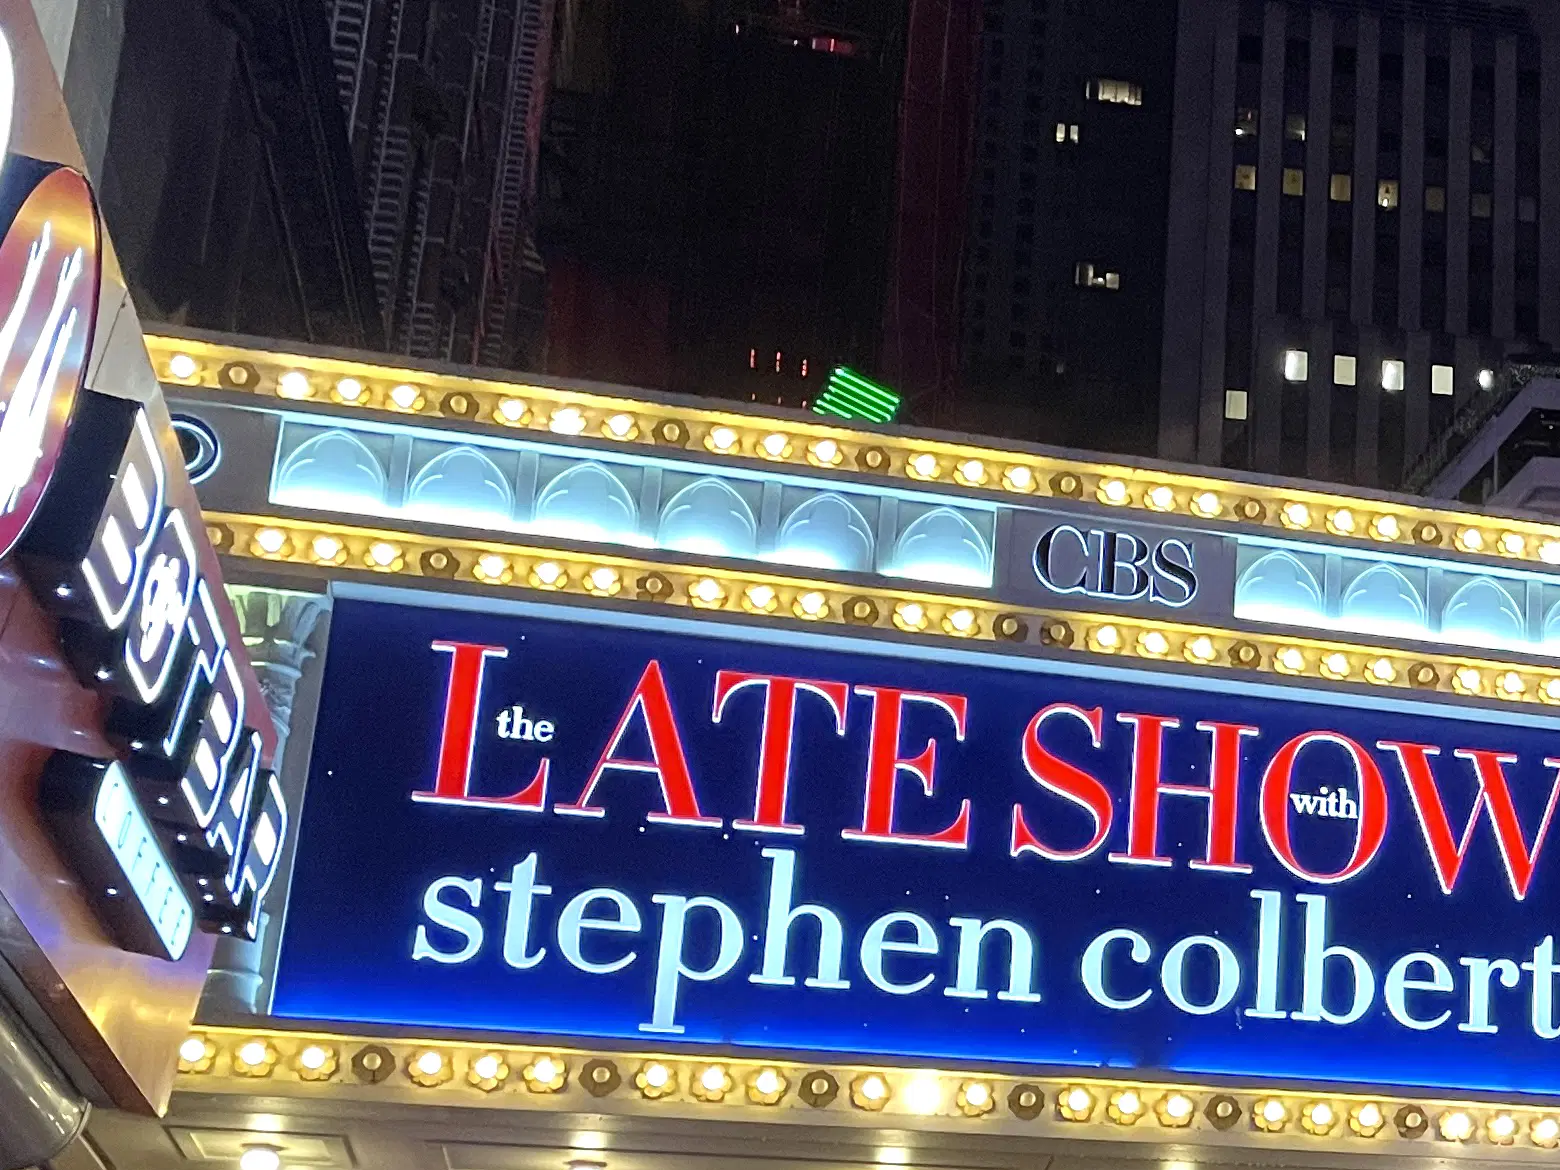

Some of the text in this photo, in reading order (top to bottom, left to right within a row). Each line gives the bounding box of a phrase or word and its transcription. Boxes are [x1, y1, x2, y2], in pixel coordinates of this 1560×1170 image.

[1032, 524, 1199, 607] CBS
[411, 640, 971, 849] LATE
[496, 706, 556, 743] the
[1291, 787, 1359, 820] with
[411, 847, 1042, 1033] stephen
